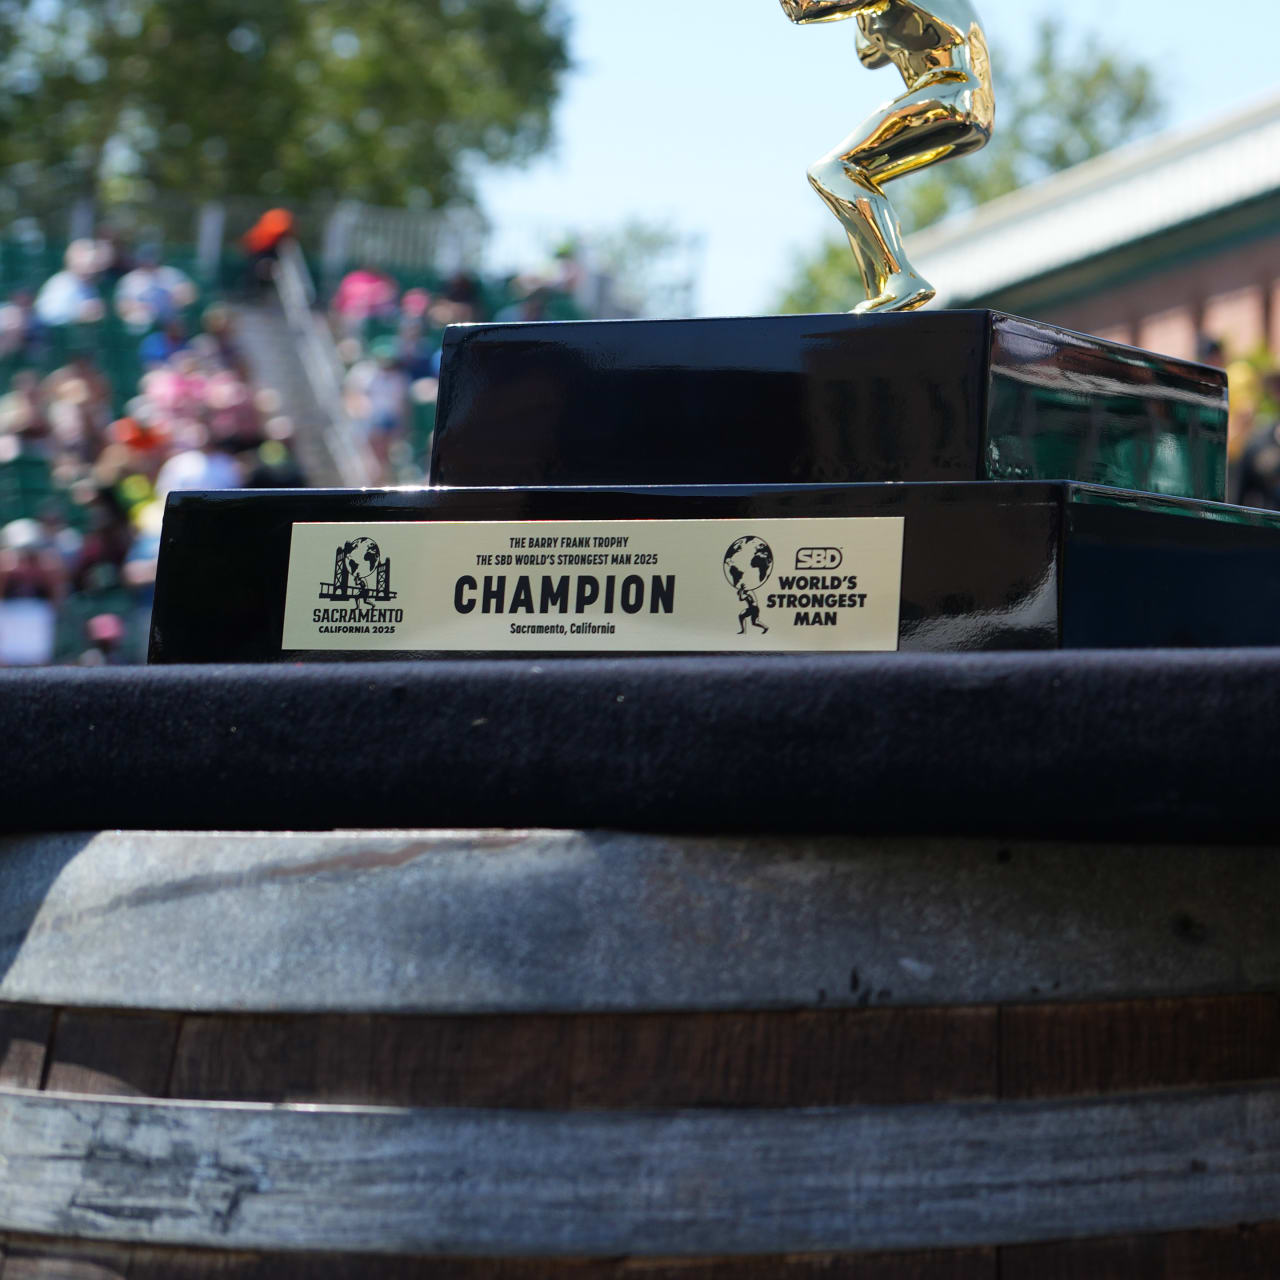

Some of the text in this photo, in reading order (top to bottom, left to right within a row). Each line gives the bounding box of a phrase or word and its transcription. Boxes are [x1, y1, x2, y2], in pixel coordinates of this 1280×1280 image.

[510, 536, 629, 549] THE BARRY FRANK TROPHY
[476, 554, 658, 566] THE SBD WORLD'S STRONGEST MAN 2025
[796, 547, 842, 570] SBD
[778, 576, 858, 590] WORLD'S
[454, 574, 676, 614] CHAMPION
[766, 594, 867, 608] STRONGEST
[312, 609, 403, 623] SACRAMENTO
[793, 611, 837, 626] MAN
[318, 626, 396, 634] CALIFORNIA 2025
[510, 622, 616, 635] Sacramento, California
